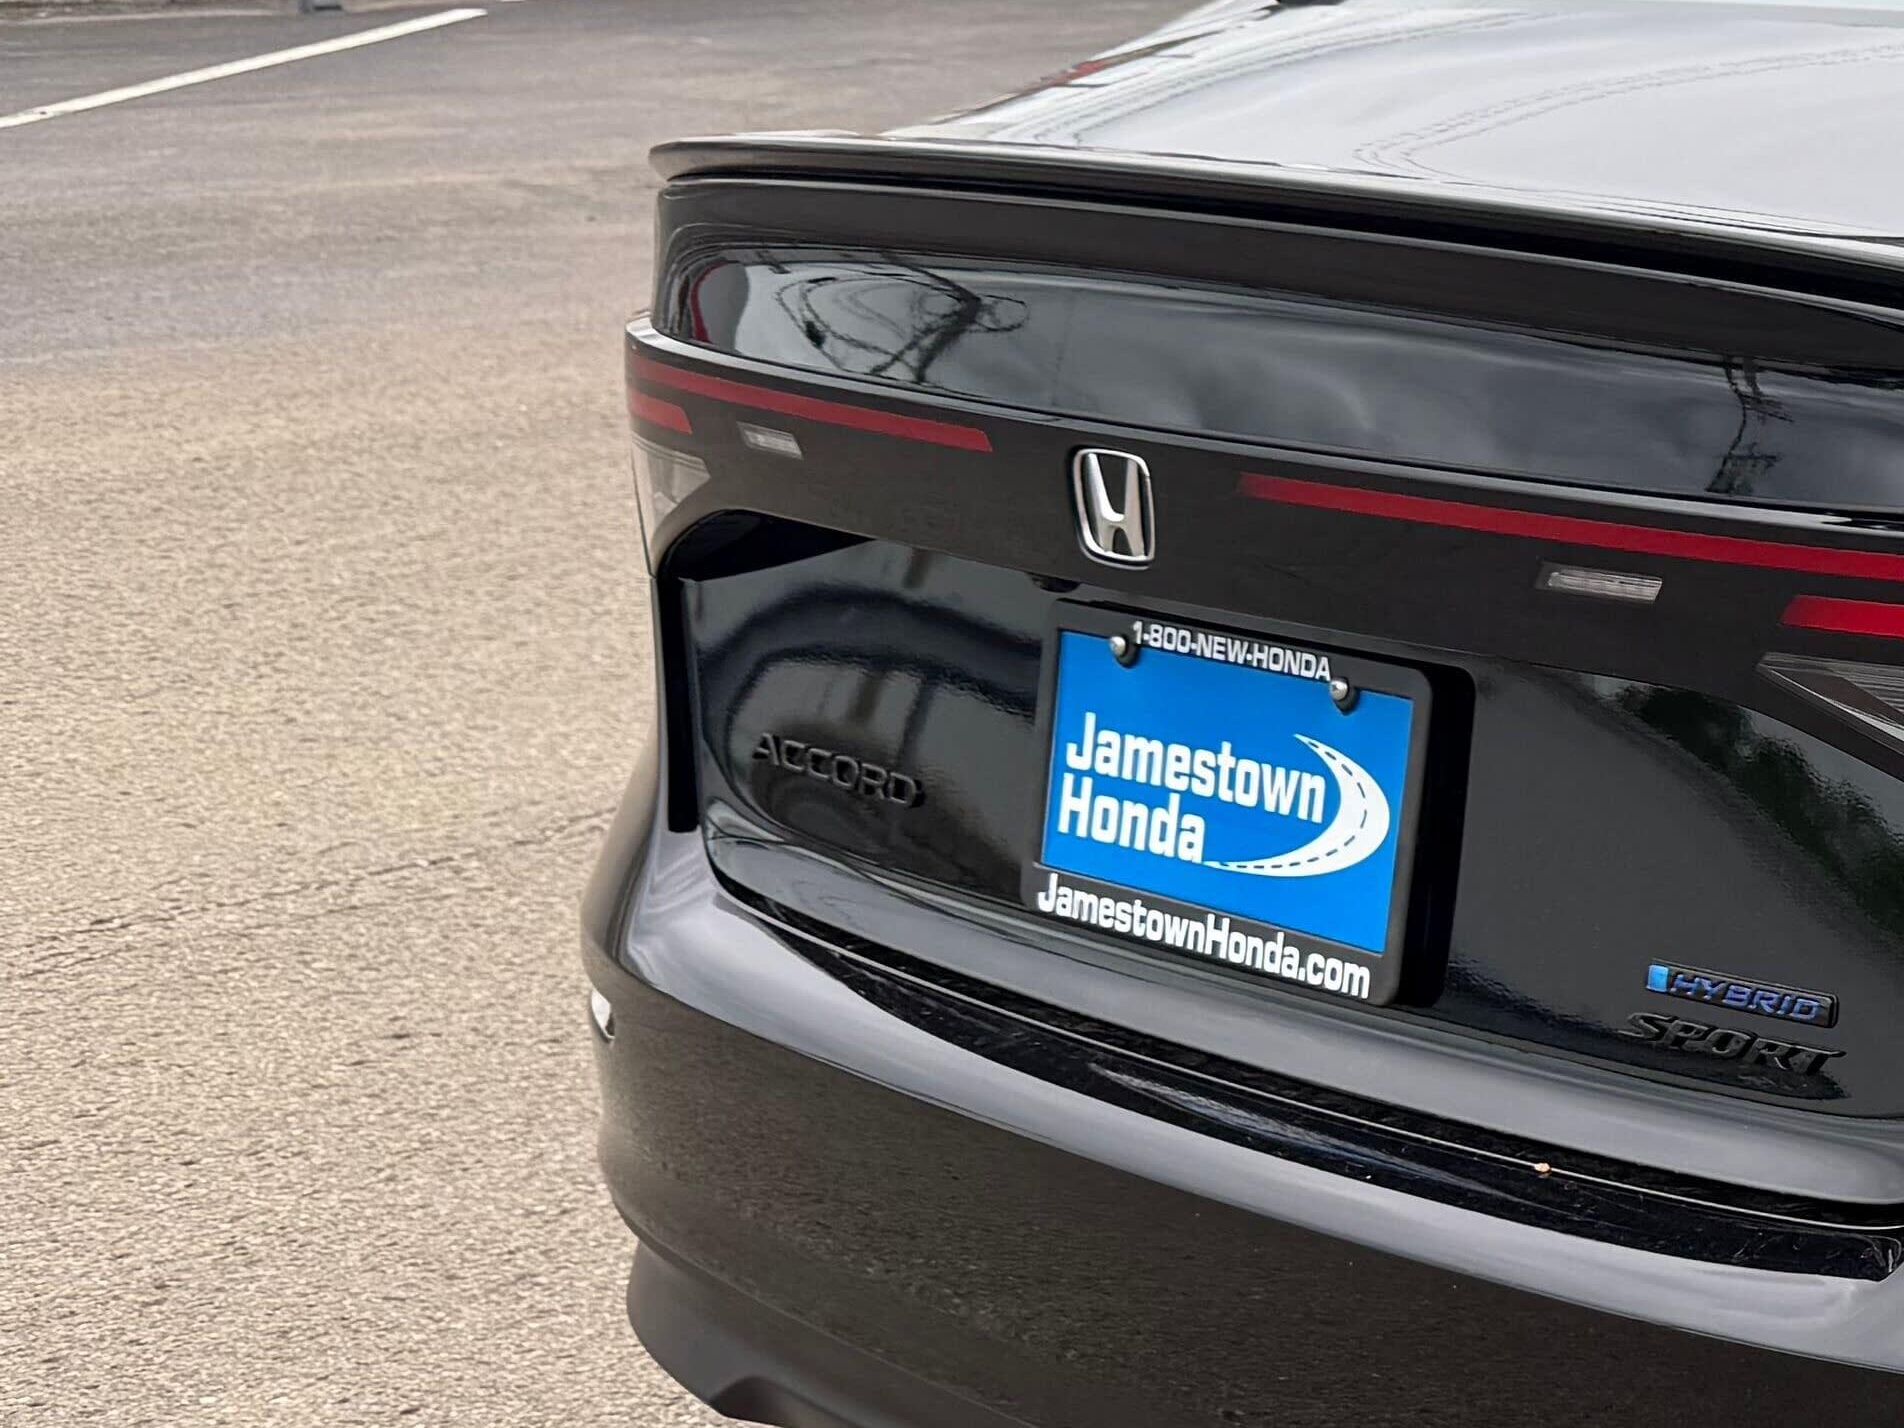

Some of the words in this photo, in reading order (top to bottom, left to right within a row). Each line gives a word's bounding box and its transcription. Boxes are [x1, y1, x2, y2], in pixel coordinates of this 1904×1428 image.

[1132, 621, 1332, 682] 1-800-NEW-HONDA
[752, 732, 921, 806] ACCORD
[1066, 711, 1327, 824] Jamestown
[1057, 772, 1206, 864] Honda
[1036, 872, 1371, 1000] JamestownHonda.com
[1669, 973, 1823, 1021] HYBRID
[1617, 1011, 1847, 1074] SPORT
